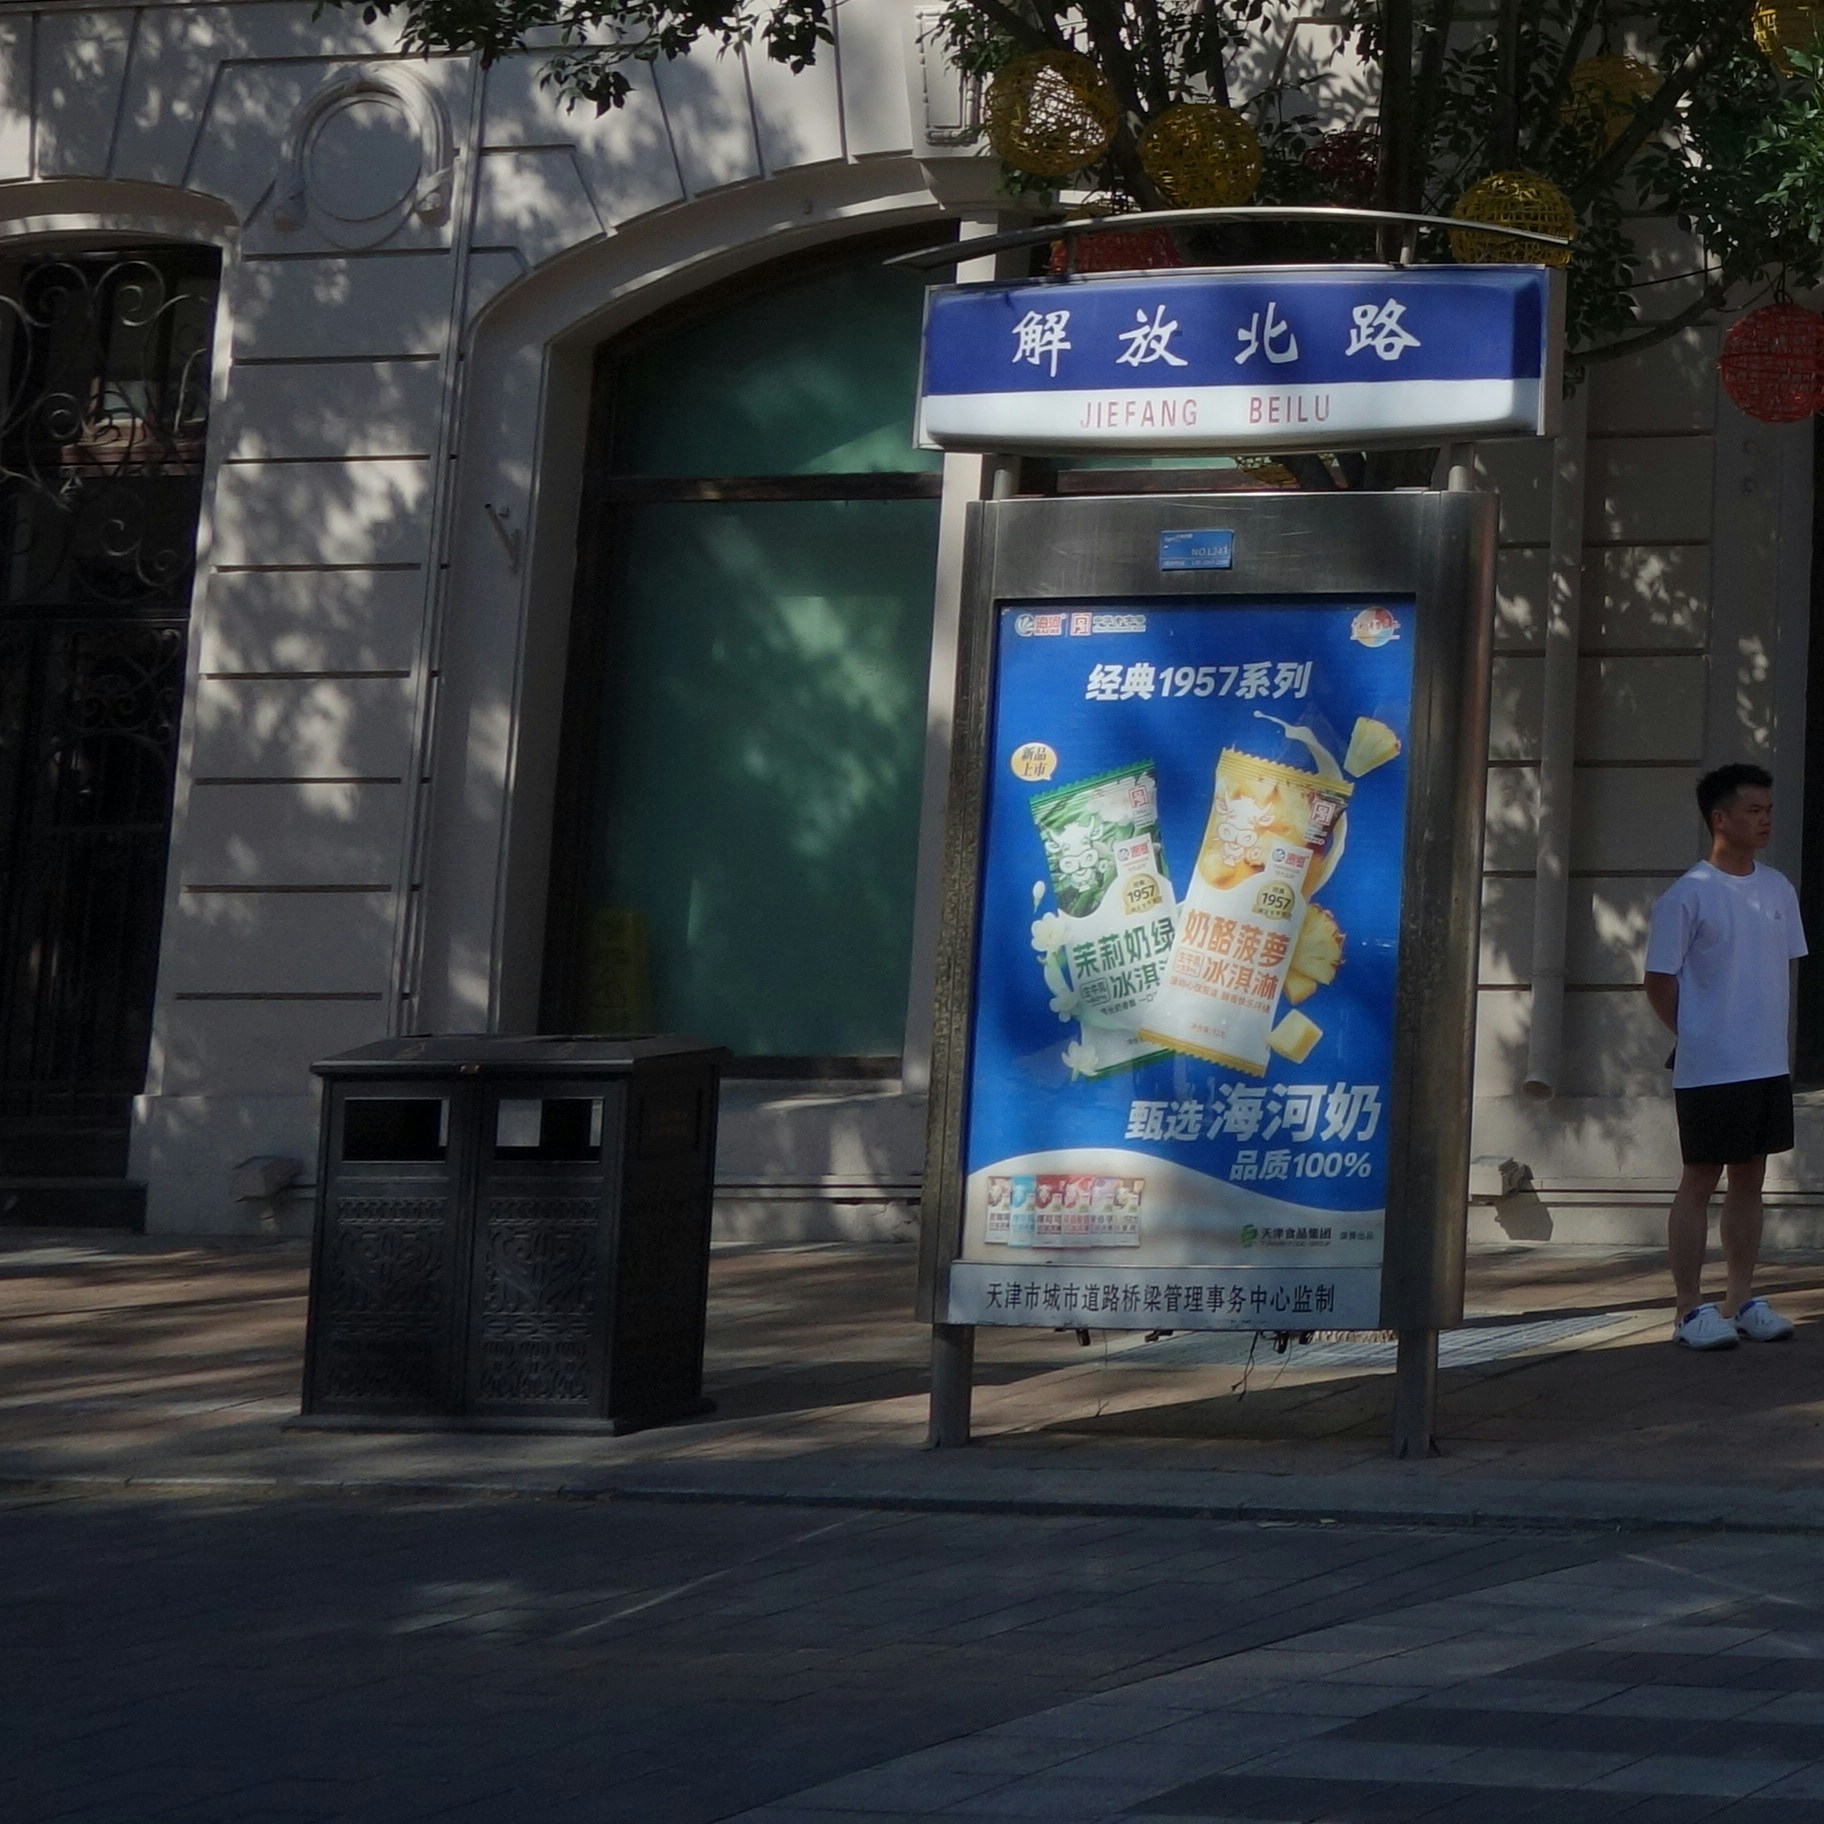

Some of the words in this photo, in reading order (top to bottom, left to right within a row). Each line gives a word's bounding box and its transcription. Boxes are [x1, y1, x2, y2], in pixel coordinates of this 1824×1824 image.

[1011, 297, 1422, 378] 解放北路
[1079, 398, 1199, 429] JIEFANG
[1247, 394, 1332, 426] BEILU
[1086, 661, 1313, 701] 经典1957系列
[1020, 745, 1047, 762] 新品
[1021, 761, 1048, 778] 上市
[1126, 884, 1157, 903] 1957
[1261, 892, 1292, 911] 1957
[1073, 916, 1175, 977] 茉莉奶绿
[1181, 908, 1291, 969] 奶酪菠萝
[1111, 959, 1171, 1001] 冰淇
[1202, 956, 1279, 1001] 冰淇淋
[1125, 1083, 1382, 1143] 甄选海河奶
[1229, 1149, 1372, 1183] 品质100%
[1260, 1227, 1332, 1240] 天津食品集团
[986, 1280, 1336, 1315] 天津市城市道路桥梁管理事务中心监制
